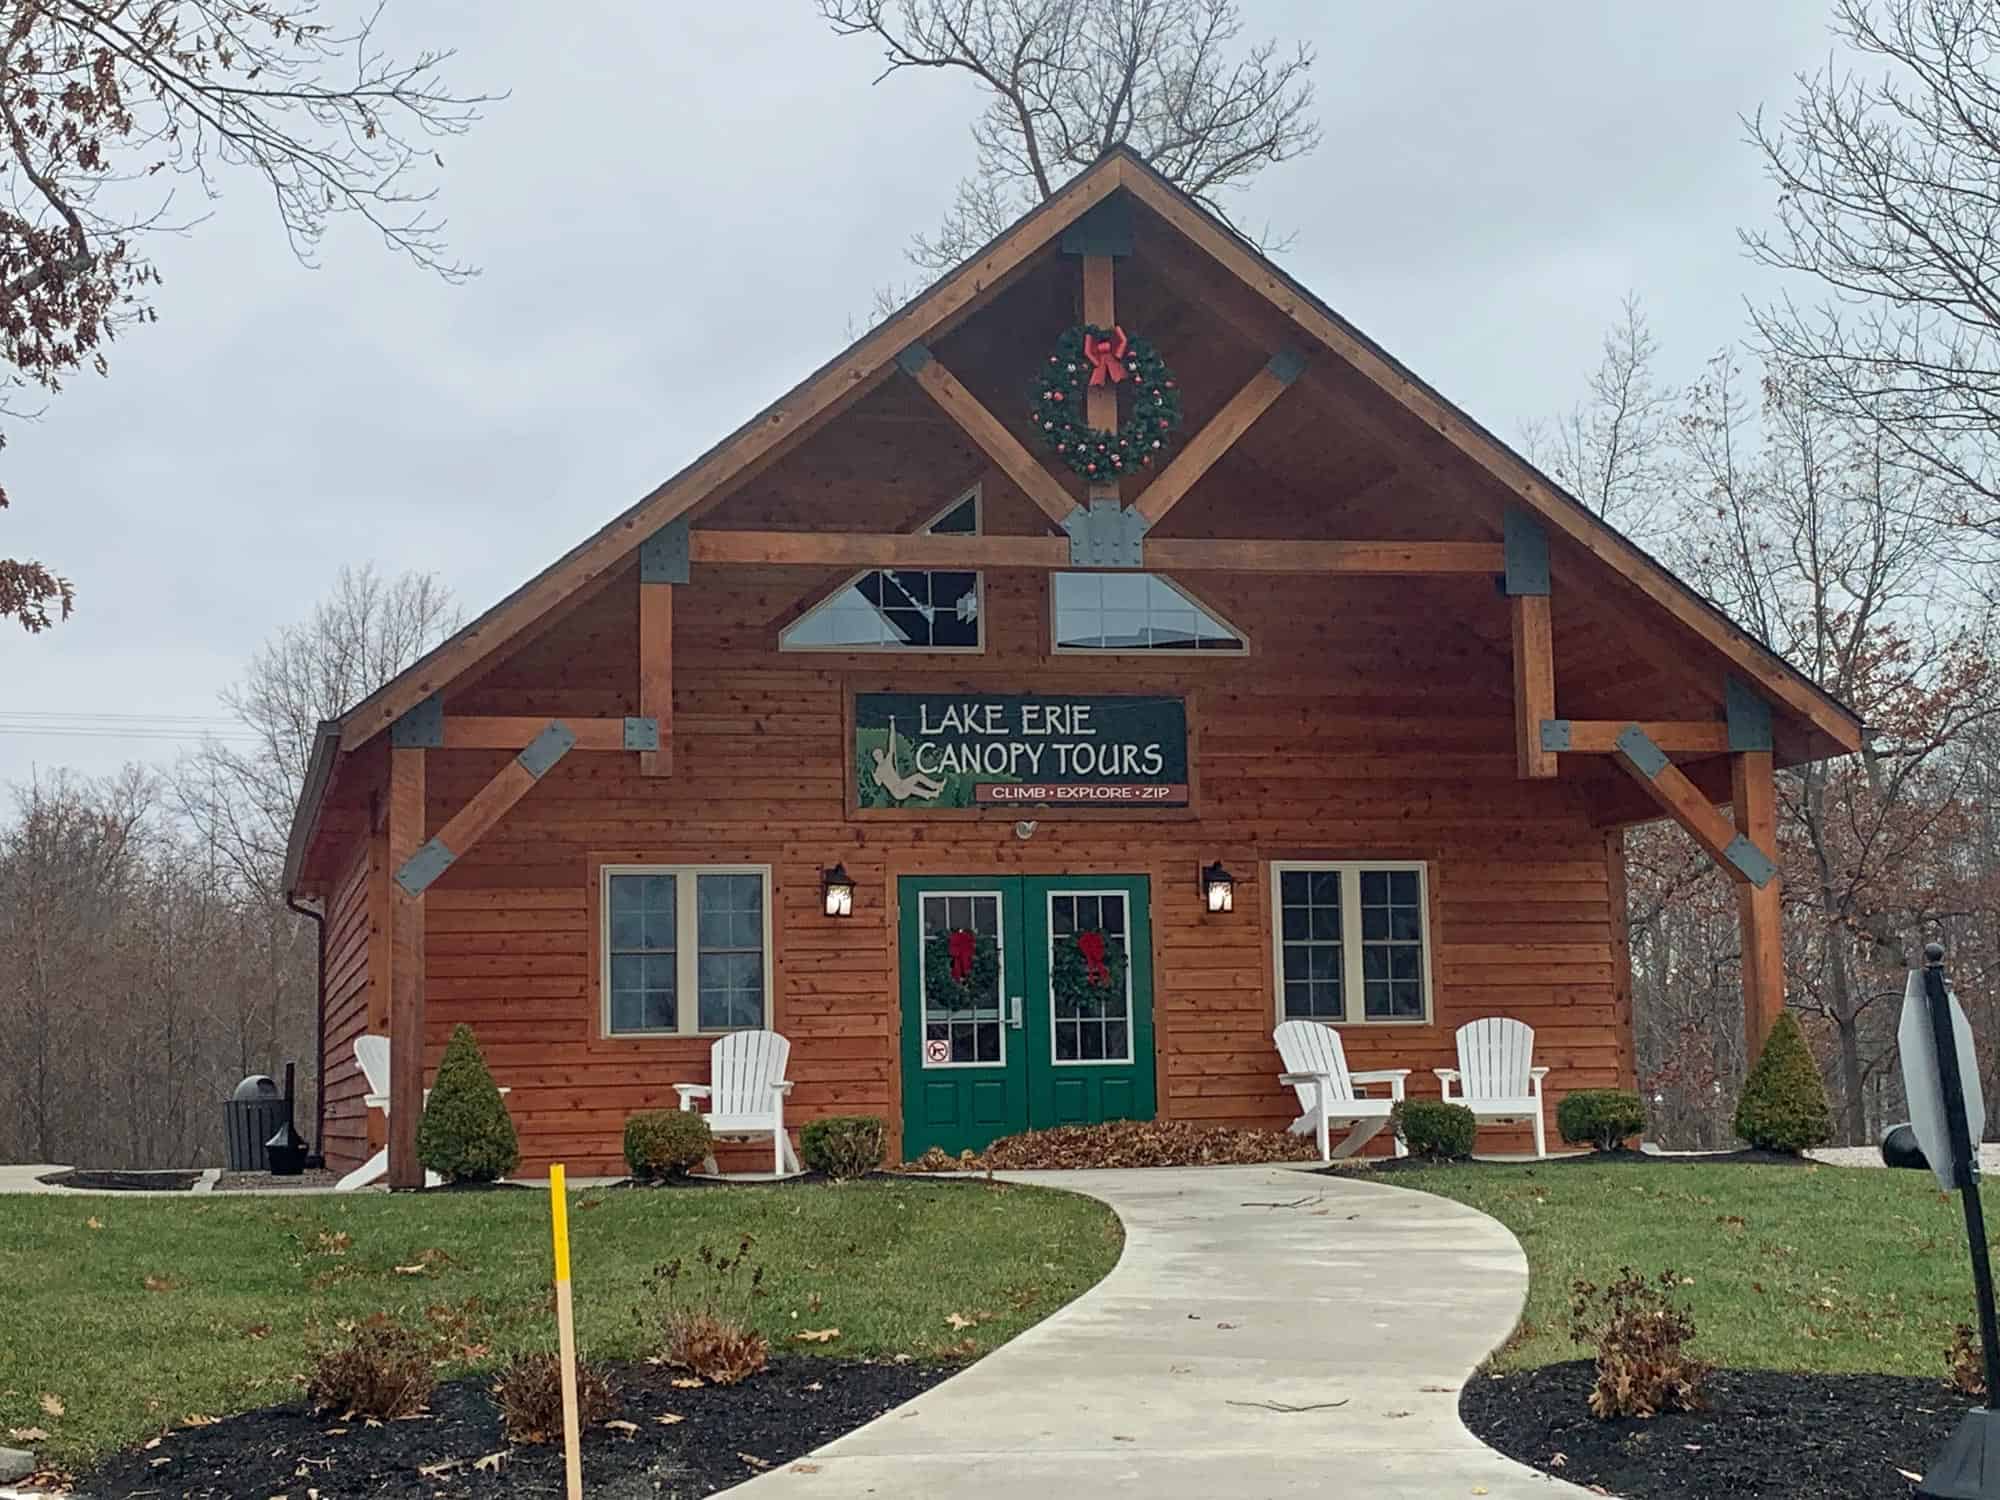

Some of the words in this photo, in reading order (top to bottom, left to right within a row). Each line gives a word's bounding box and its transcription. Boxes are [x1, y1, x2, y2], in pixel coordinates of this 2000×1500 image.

[919, 703, 1010, 735] LAKE
[1021, 704, 1097, 735] ERIE
[915, 742, 1045, 775] CANOPY
[1051, 743, 1163, 775] TOURS
[991, 786, 1047, 799] CLIMB
[1056, 786, 1132, 799] EXPLORE
[1141, 786, 1170, 799] ZIP
